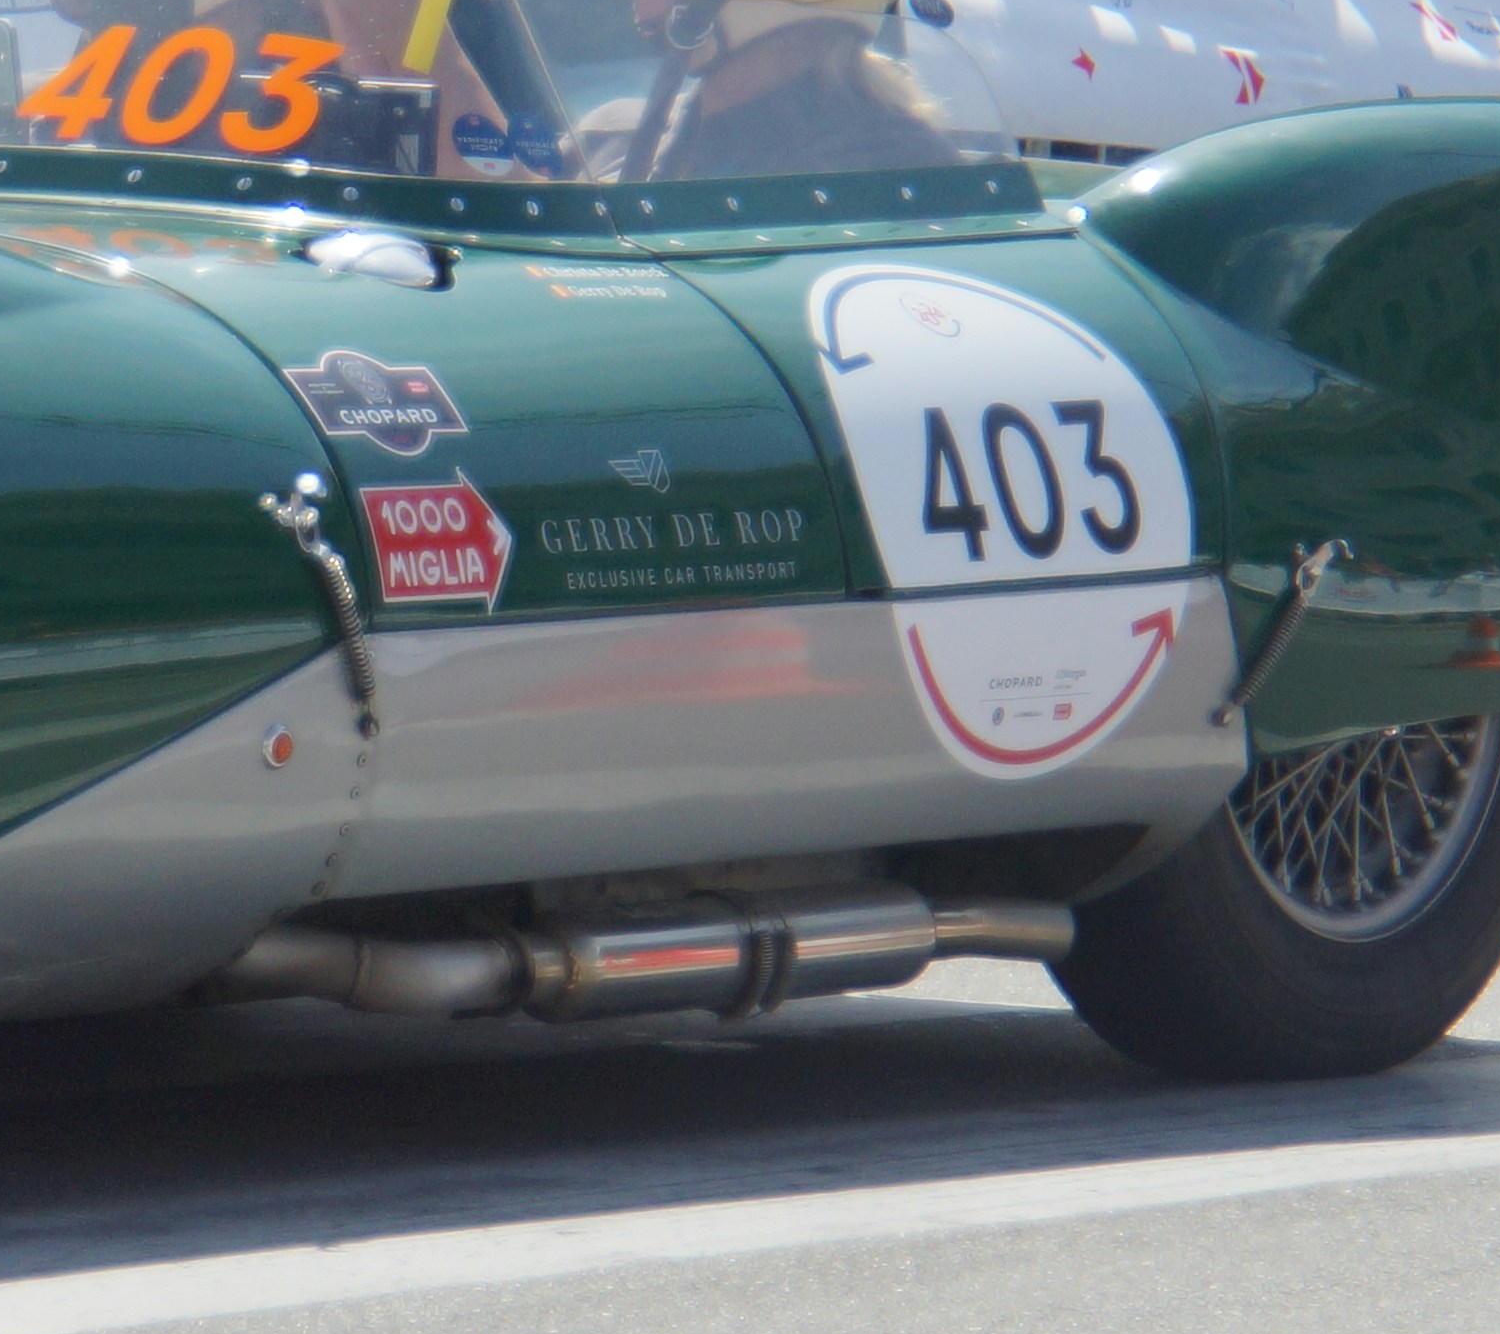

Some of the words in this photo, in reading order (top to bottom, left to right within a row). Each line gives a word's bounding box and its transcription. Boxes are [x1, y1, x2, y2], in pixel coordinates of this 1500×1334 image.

[16, 24, 345, 153] 403
[339, 408, 439, 425] CHOPARD
[922, 399, 1142, 562] 403
[381, 497, 467, 536] 1000
[540, 514, 656, 555] GERRY
[671, 512, 721, 548] DE
[734, 508, 803, 545] ROP
[389, 547, 485, 588] MIGLIA
[567, 568, 657, 591] EXCLUSIVE
[664, 566, 697, 585] CAR
[703, 561, 797, 583] TRANSPORT
[989, 675, 1043, 690] CHOPARD
